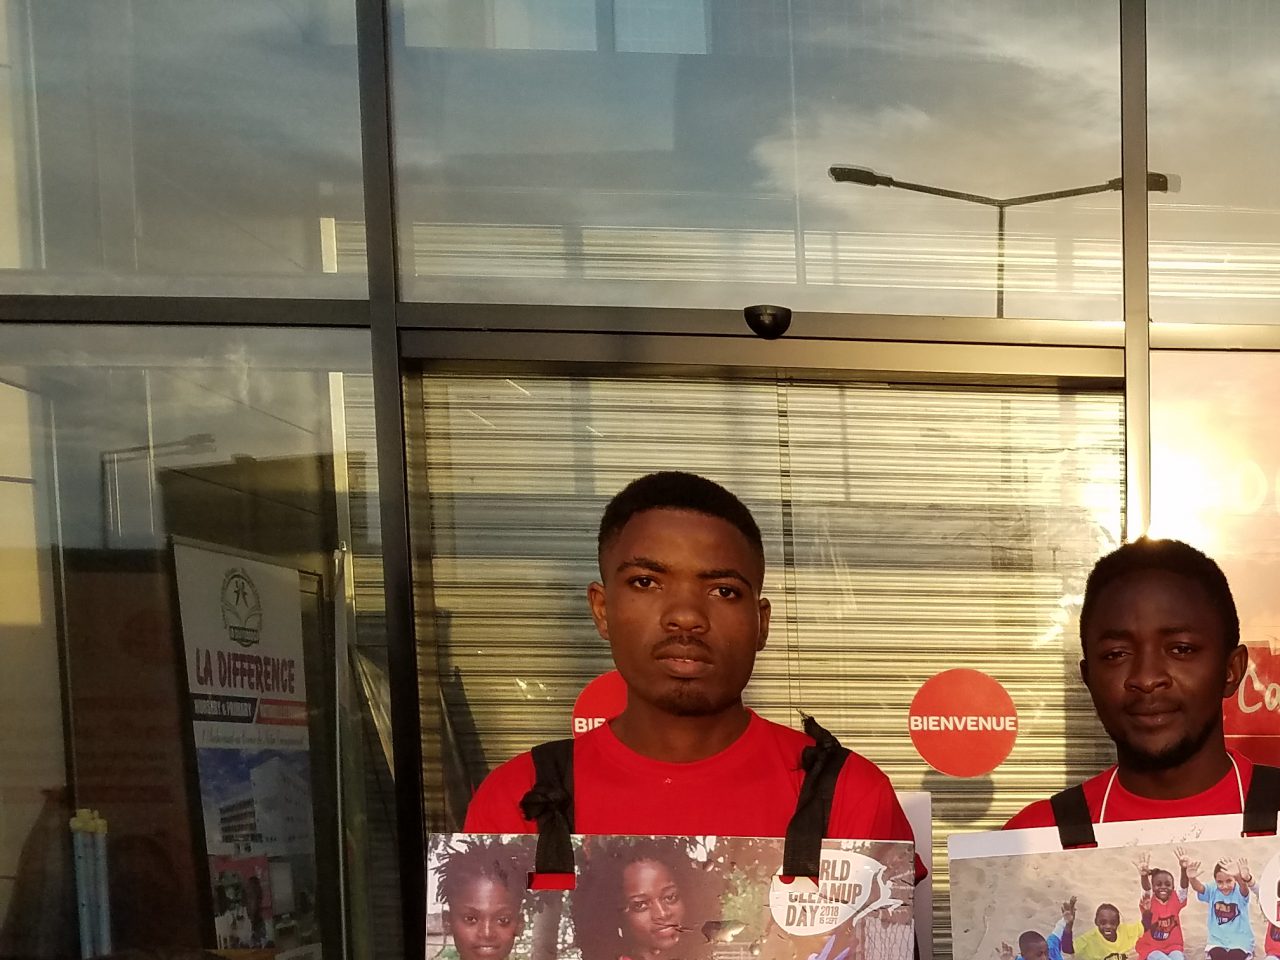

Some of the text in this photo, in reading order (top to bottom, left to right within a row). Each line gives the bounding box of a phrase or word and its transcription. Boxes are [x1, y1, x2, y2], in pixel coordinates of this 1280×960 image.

[196, 648, 295, 694] LA DIFFERENCE
[910, 715, 1017, 732] BIENVENUE
[820, 859, 850, 881] RLD
[785, 905, 819, 927] DAY
